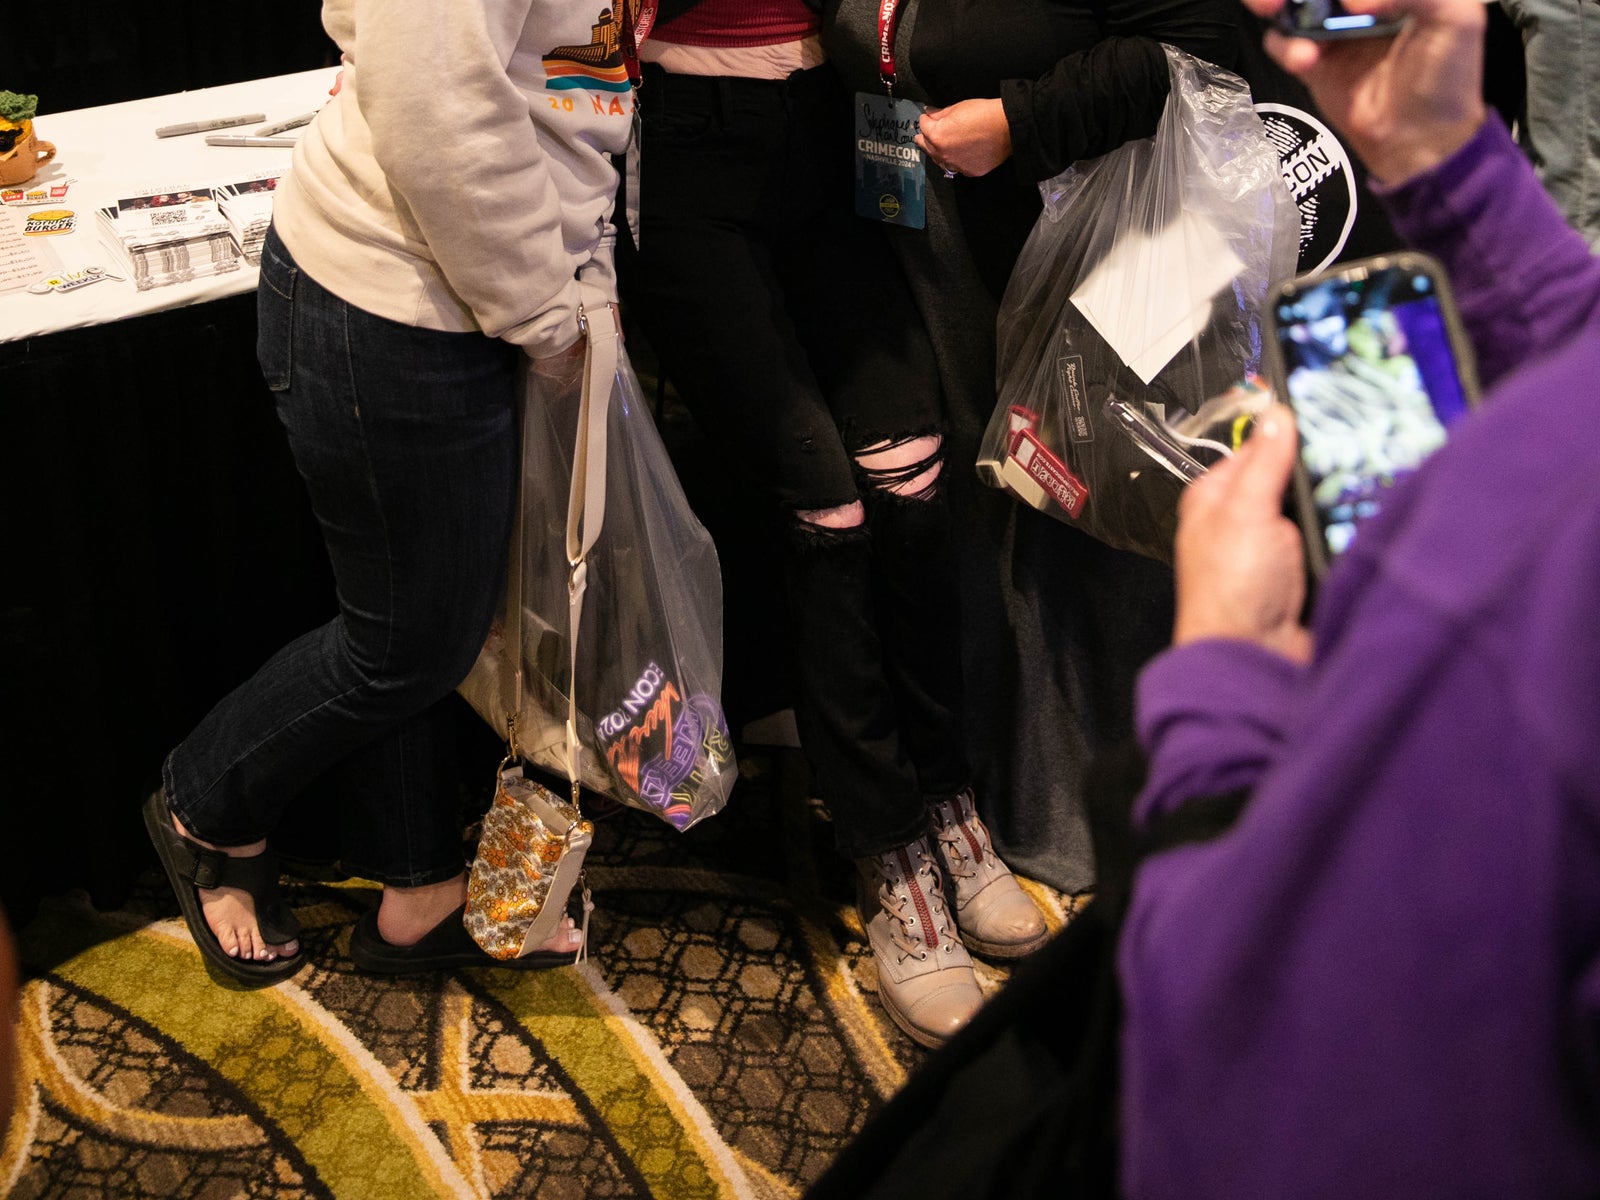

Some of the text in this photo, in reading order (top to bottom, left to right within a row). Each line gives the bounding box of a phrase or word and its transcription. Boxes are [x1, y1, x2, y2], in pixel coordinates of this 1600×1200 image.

[547, 97, 575, 113] 20
[858, 139, 920, 162] CRIMECON
[866, 154, 912, 168] NASHVILLE 2024
[24, 222, 73, 232] BURGER
[27, 218, 74, 226] NOTHING
